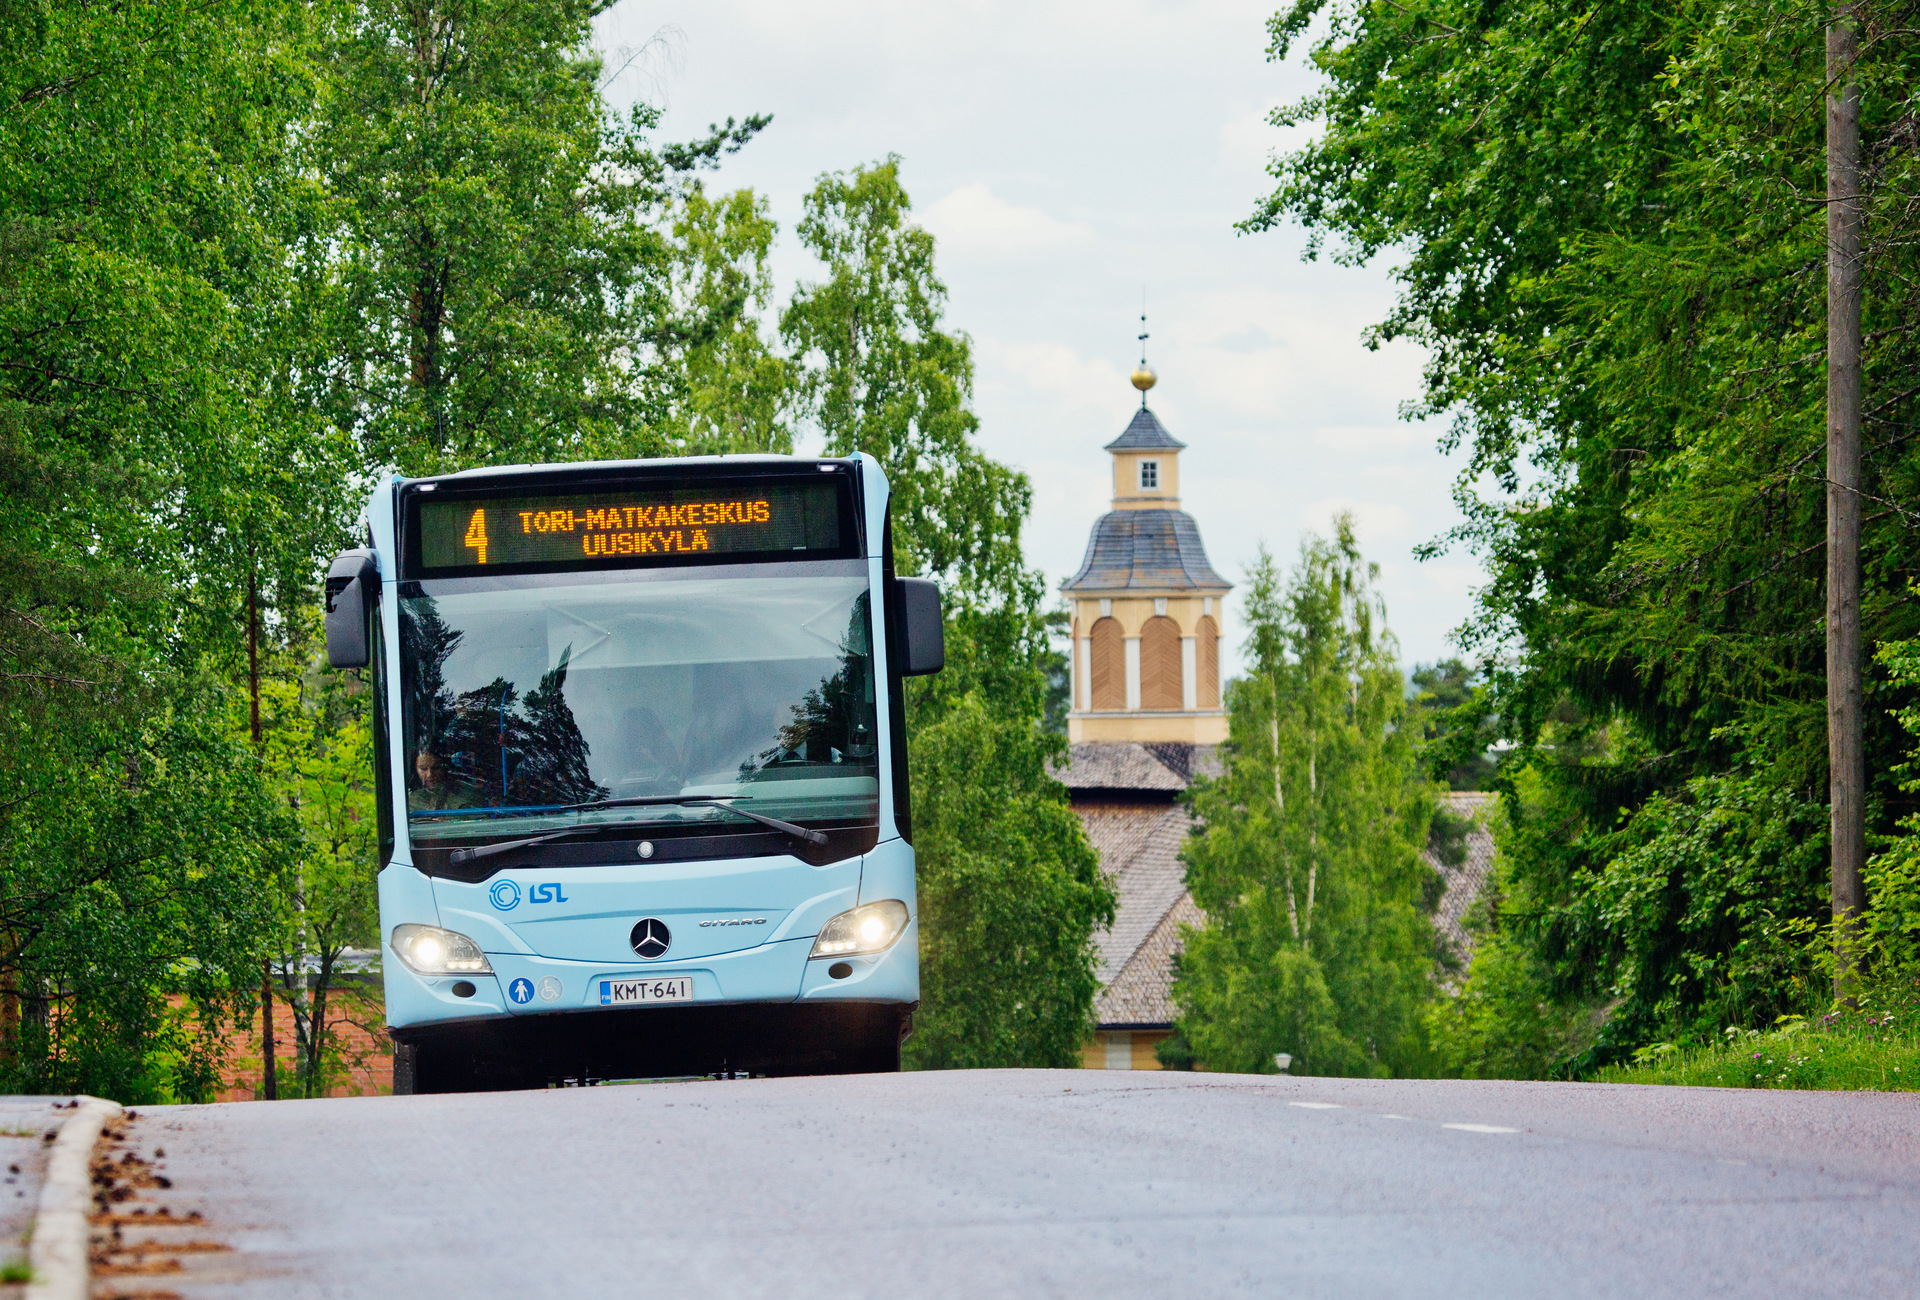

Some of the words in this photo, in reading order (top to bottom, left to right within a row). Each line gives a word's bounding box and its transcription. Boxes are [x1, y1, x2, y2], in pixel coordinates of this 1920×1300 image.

[518, 501, 770, 533] TORI-MATKAKESKUS
[465, 508, 488, 564] 4
[583, 529, 708, 556] UUSIKYLÄ
[529, 882, 569, 904] LSL
[699, 917, 767, 928] CITARO
[614, 980, 685, 1001] KMT-641
